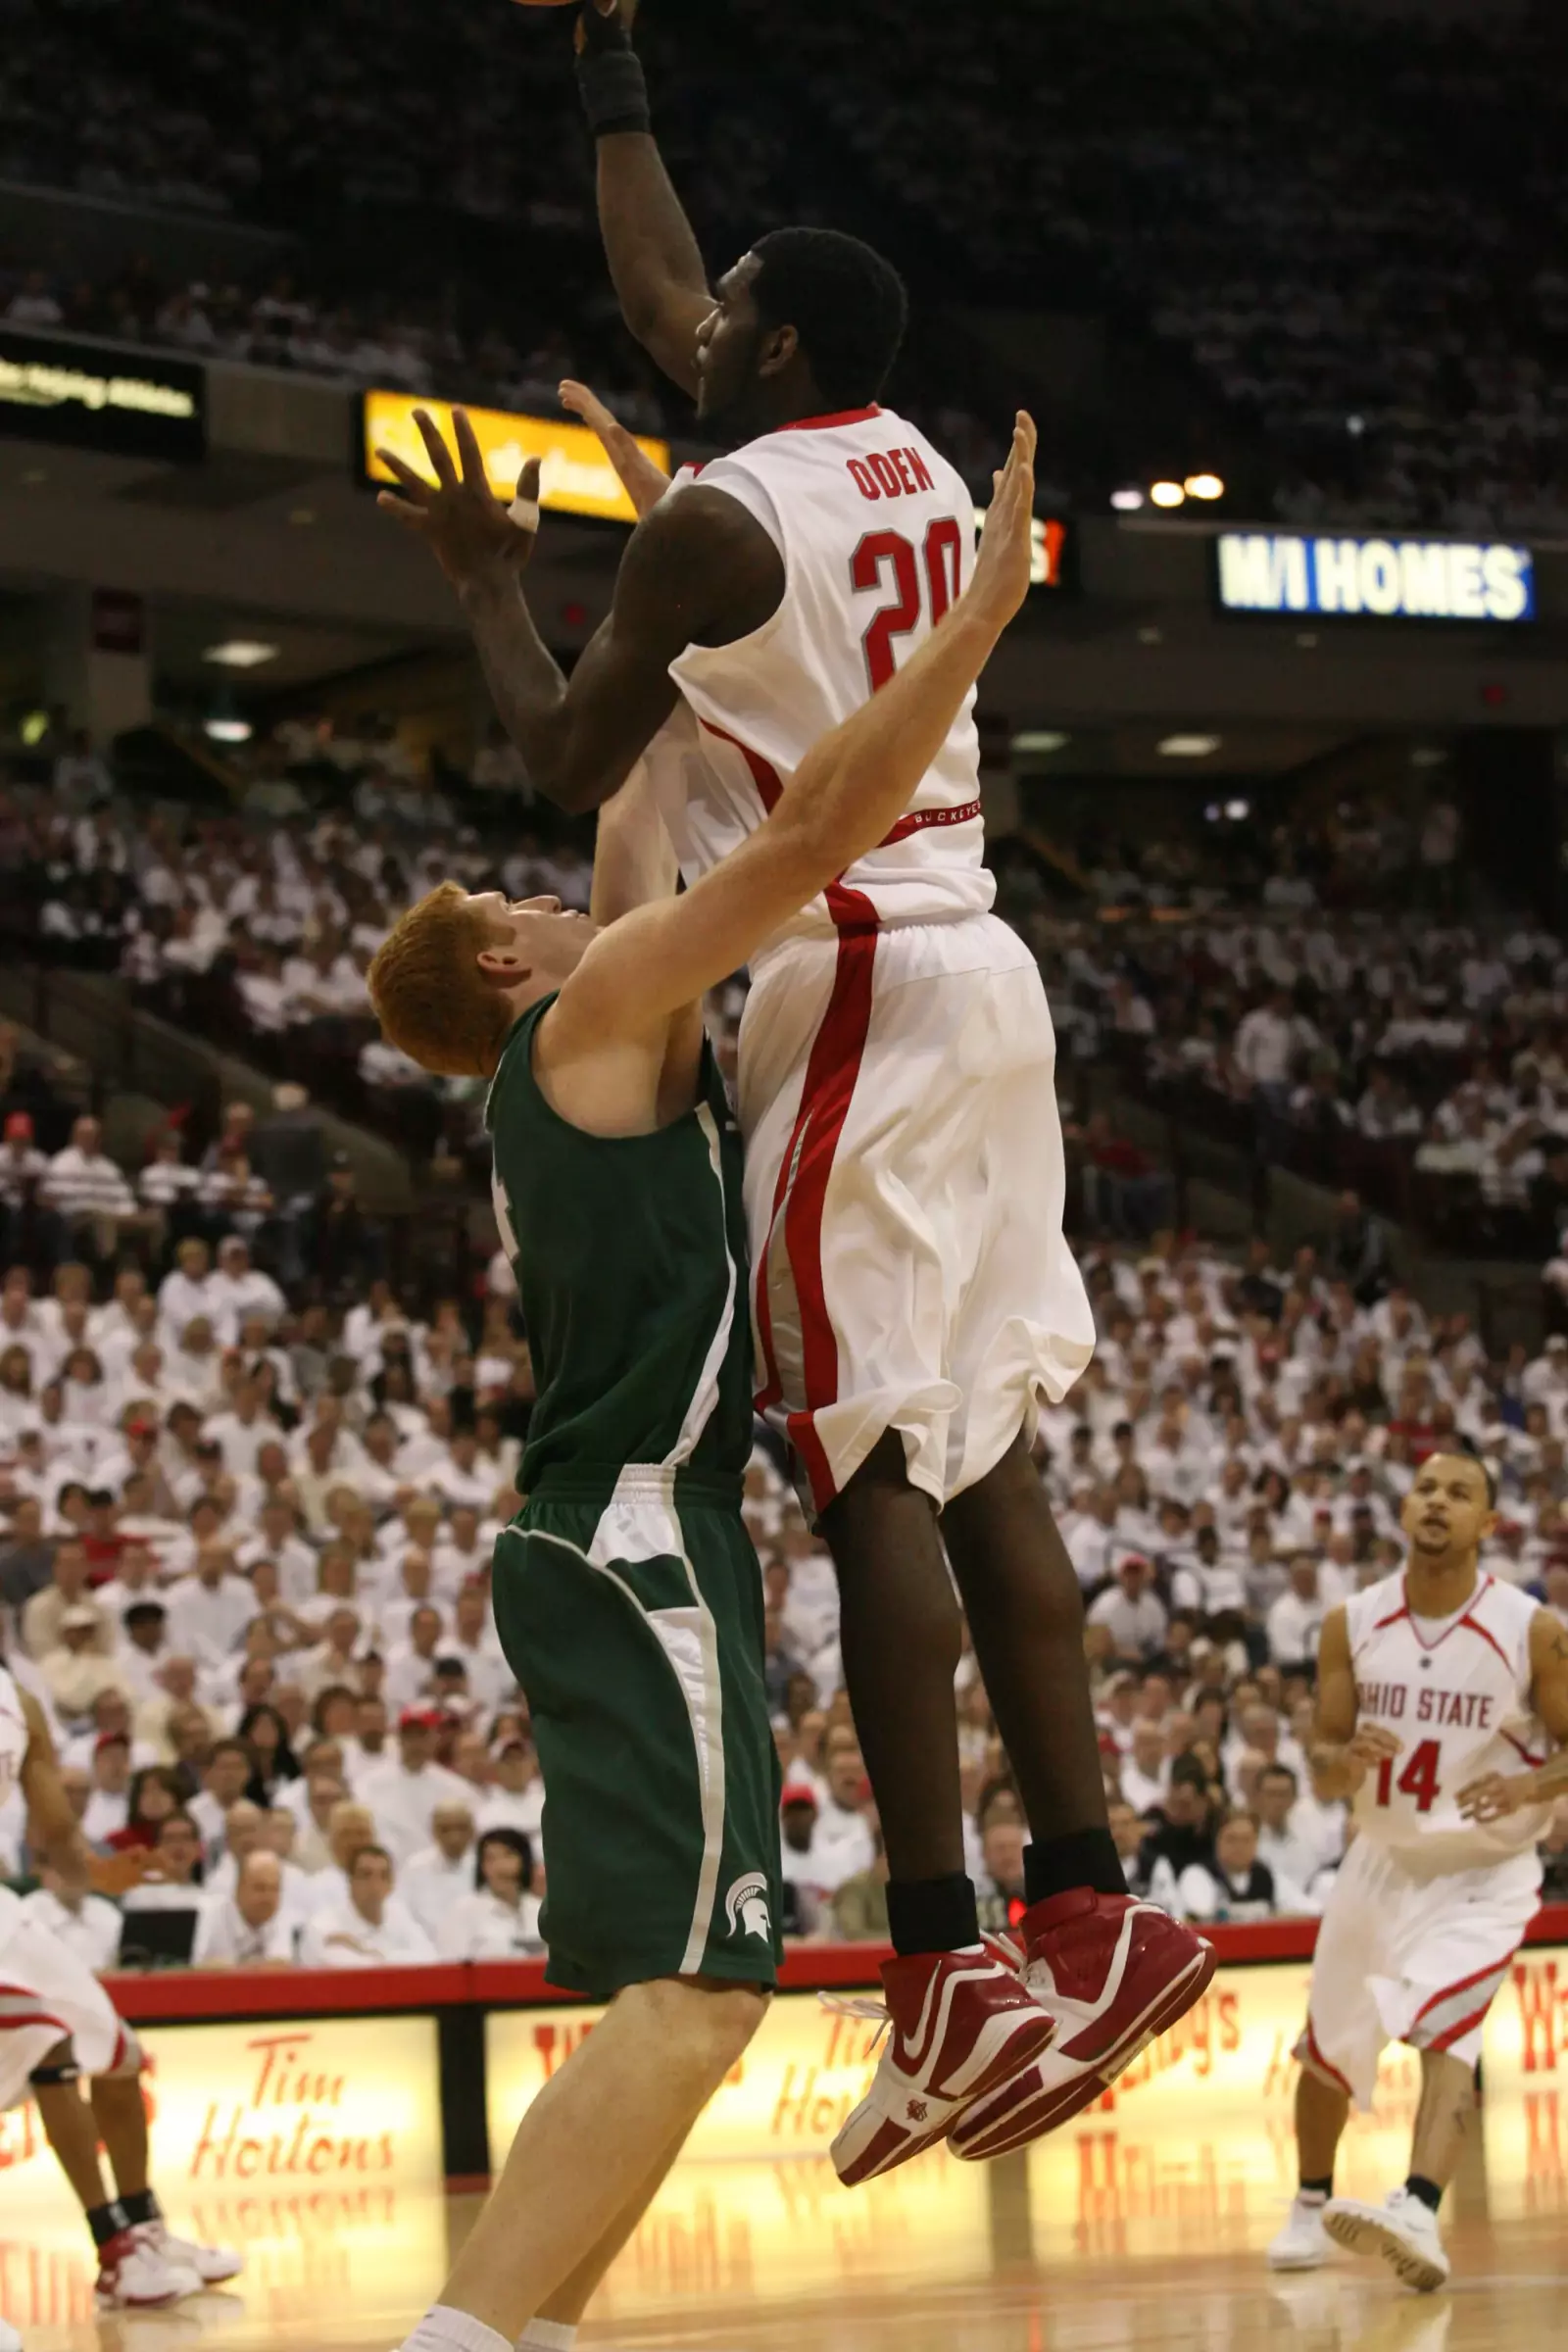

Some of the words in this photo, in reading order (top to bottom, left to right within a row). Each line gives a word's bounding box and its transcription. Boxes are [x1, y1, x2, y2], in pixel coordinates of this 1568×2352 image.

[846, 446, 936, 502] ODEN
[849, 514, 962, 702] 20
[1314, 537, 1529, 620] HOMES
[913, 799, 981, 824] BUCKEYE
[1417, 1687, 1494, 1730] STATE
[1375, 1738, 1442, 1812] 14
[247, 2032, 346, 2108] Tim
[189, 2101, 395, 2180] Hortons
